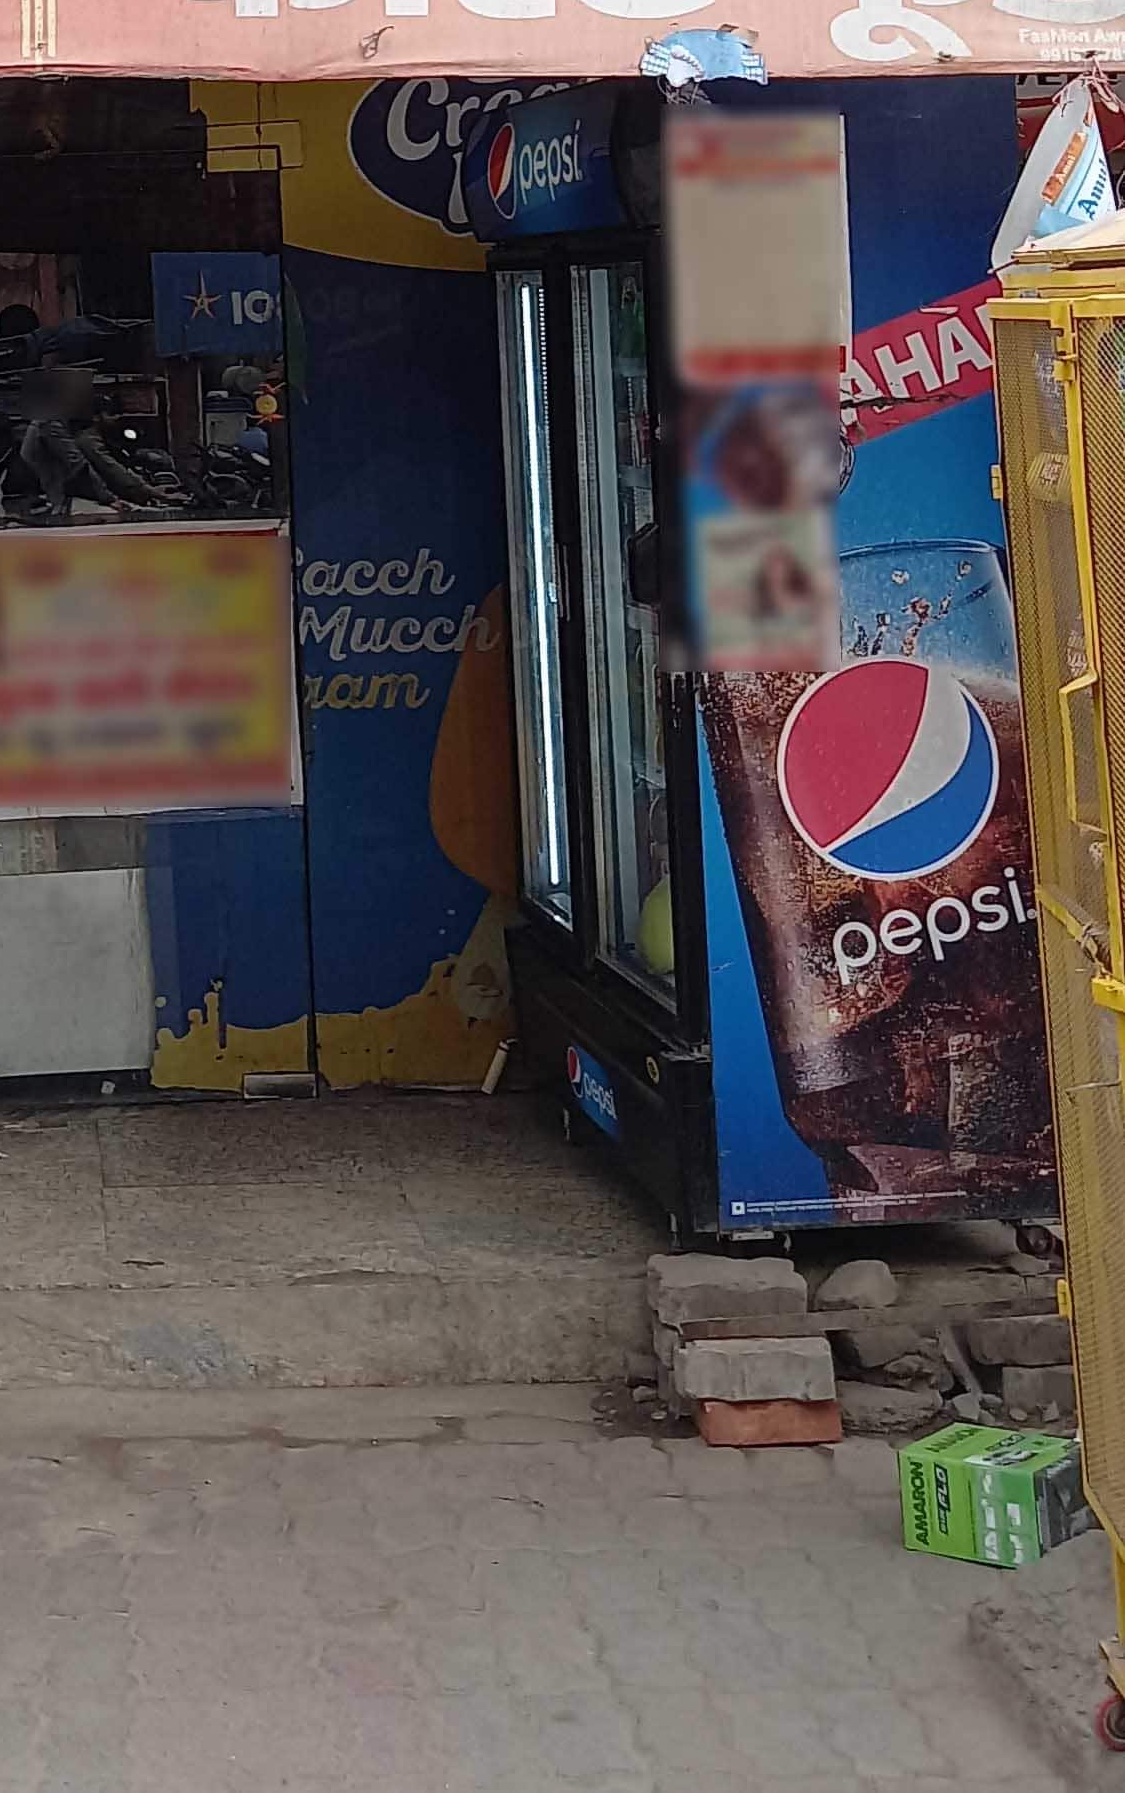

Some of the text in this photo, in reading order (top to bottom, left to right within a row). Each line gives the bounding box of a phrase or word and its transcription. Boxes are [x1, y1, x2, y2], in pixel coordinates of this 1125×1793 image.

[518, 118, 583, 207] pepsi
[832, 867, 1029, 986] pepsi
[909, 1460, 930, 1546] AMARON
